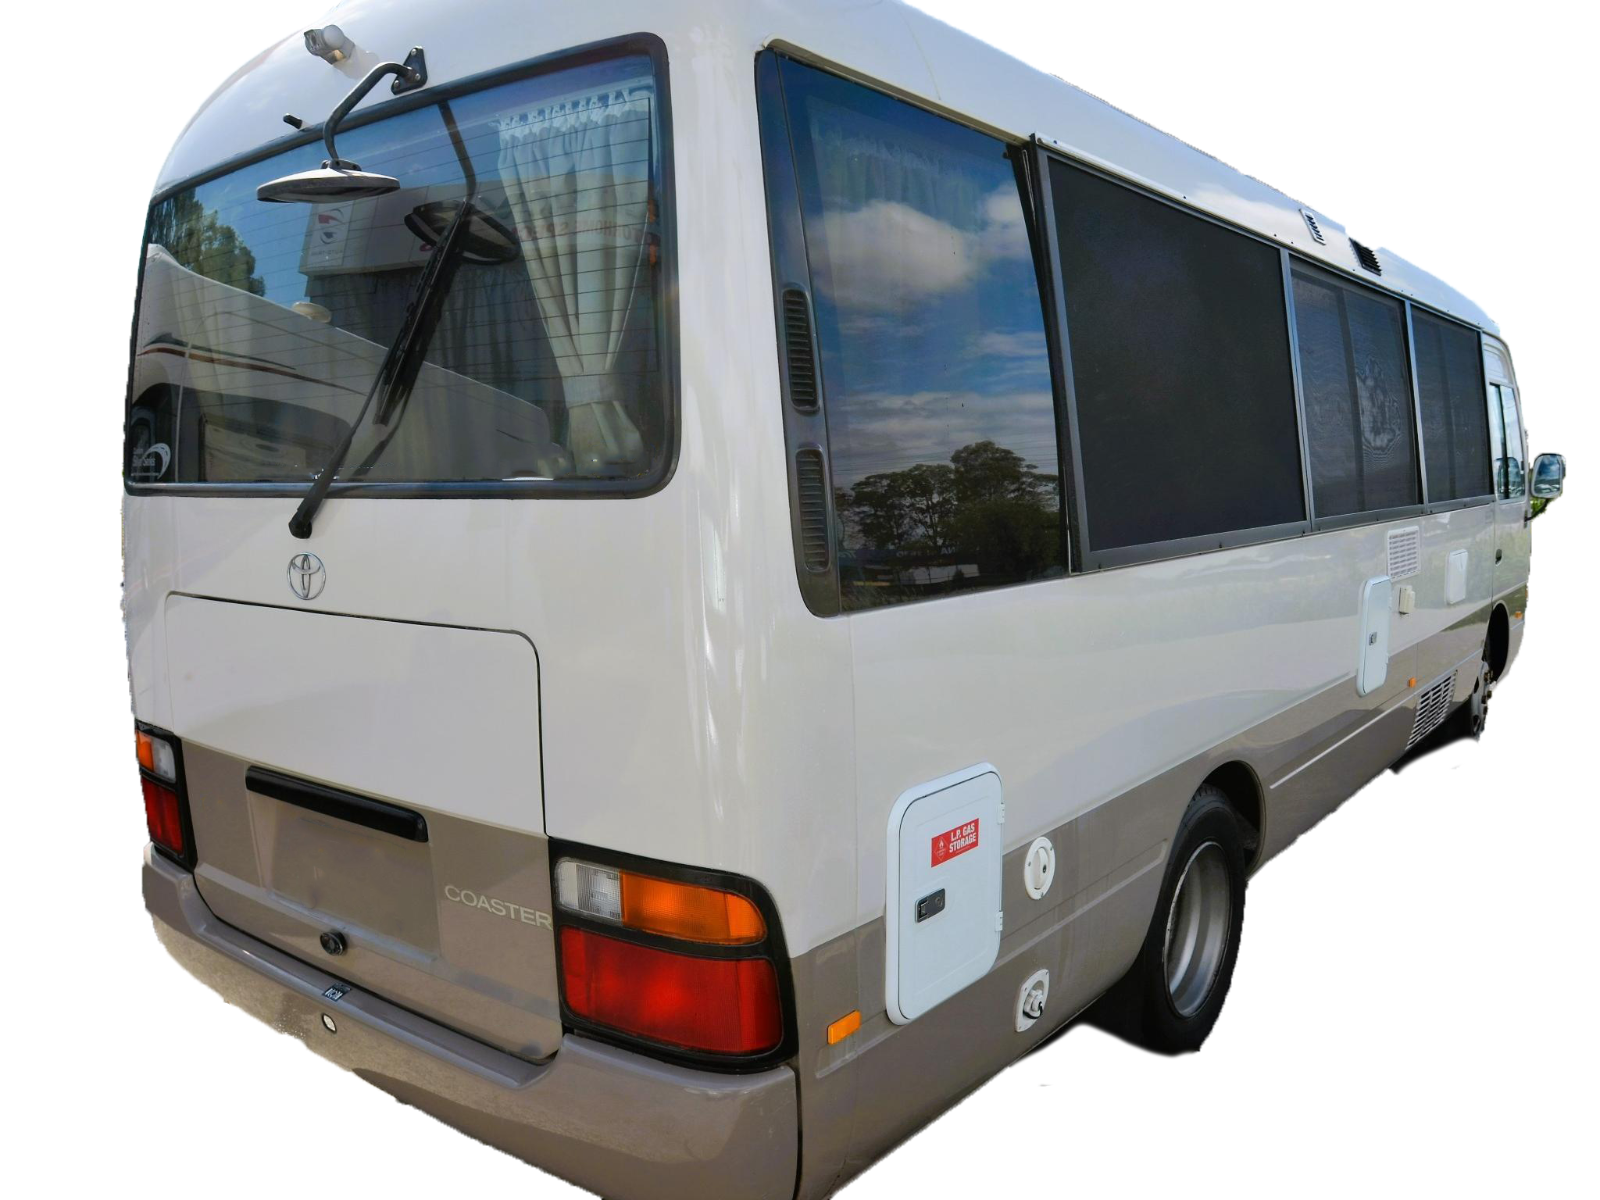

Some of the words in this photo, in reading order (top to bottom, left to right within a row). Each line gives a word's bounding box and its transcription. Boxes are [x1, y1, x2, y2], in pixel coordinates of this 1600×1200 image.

[963, 823, 975, 837] GAS
[949, 832, 977, 853] STORAGE
[444, 885, 553, 931] COASTER
